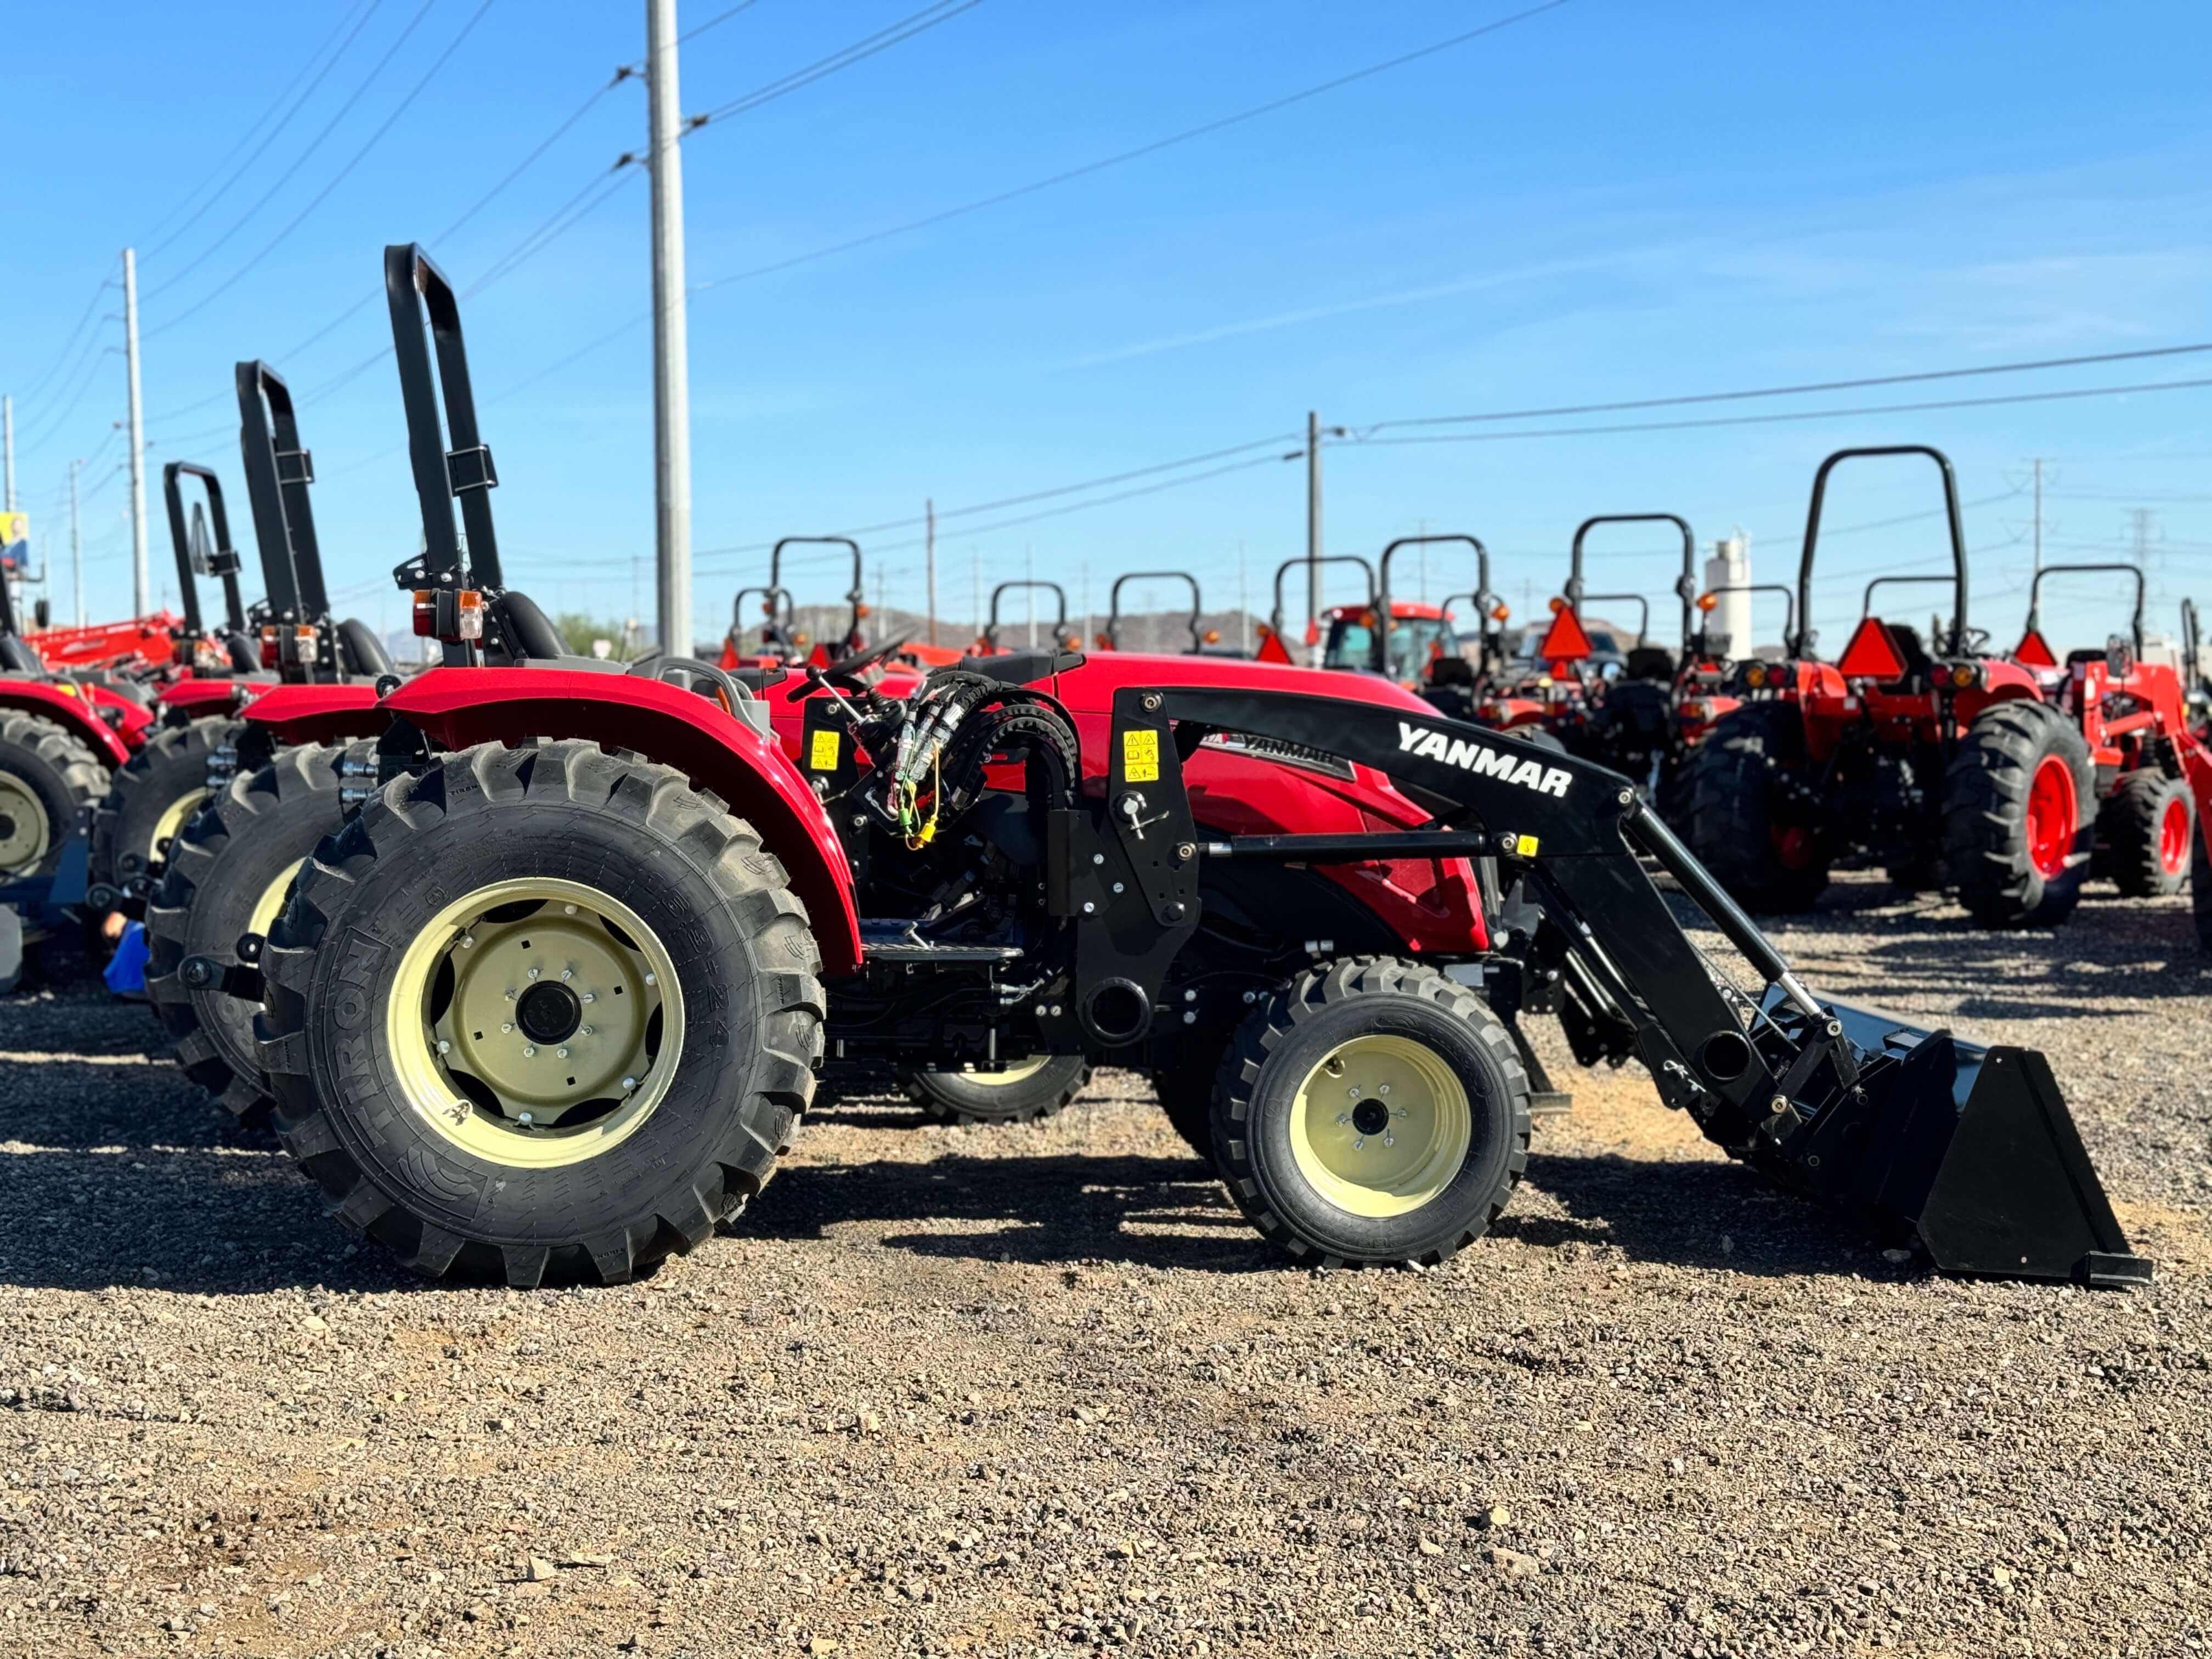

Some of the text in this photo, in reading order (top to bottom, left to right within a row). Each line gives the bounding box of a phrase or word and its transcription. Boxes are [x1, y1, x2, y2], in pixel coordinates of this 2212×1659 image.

[1242, 735, 1334, 764] YANMAR
[1399, 721, 1572, 797] YANMAR
[644, 870, 730, 1047] 16.9-24
[333, 938, 394, 1149] TIRON
